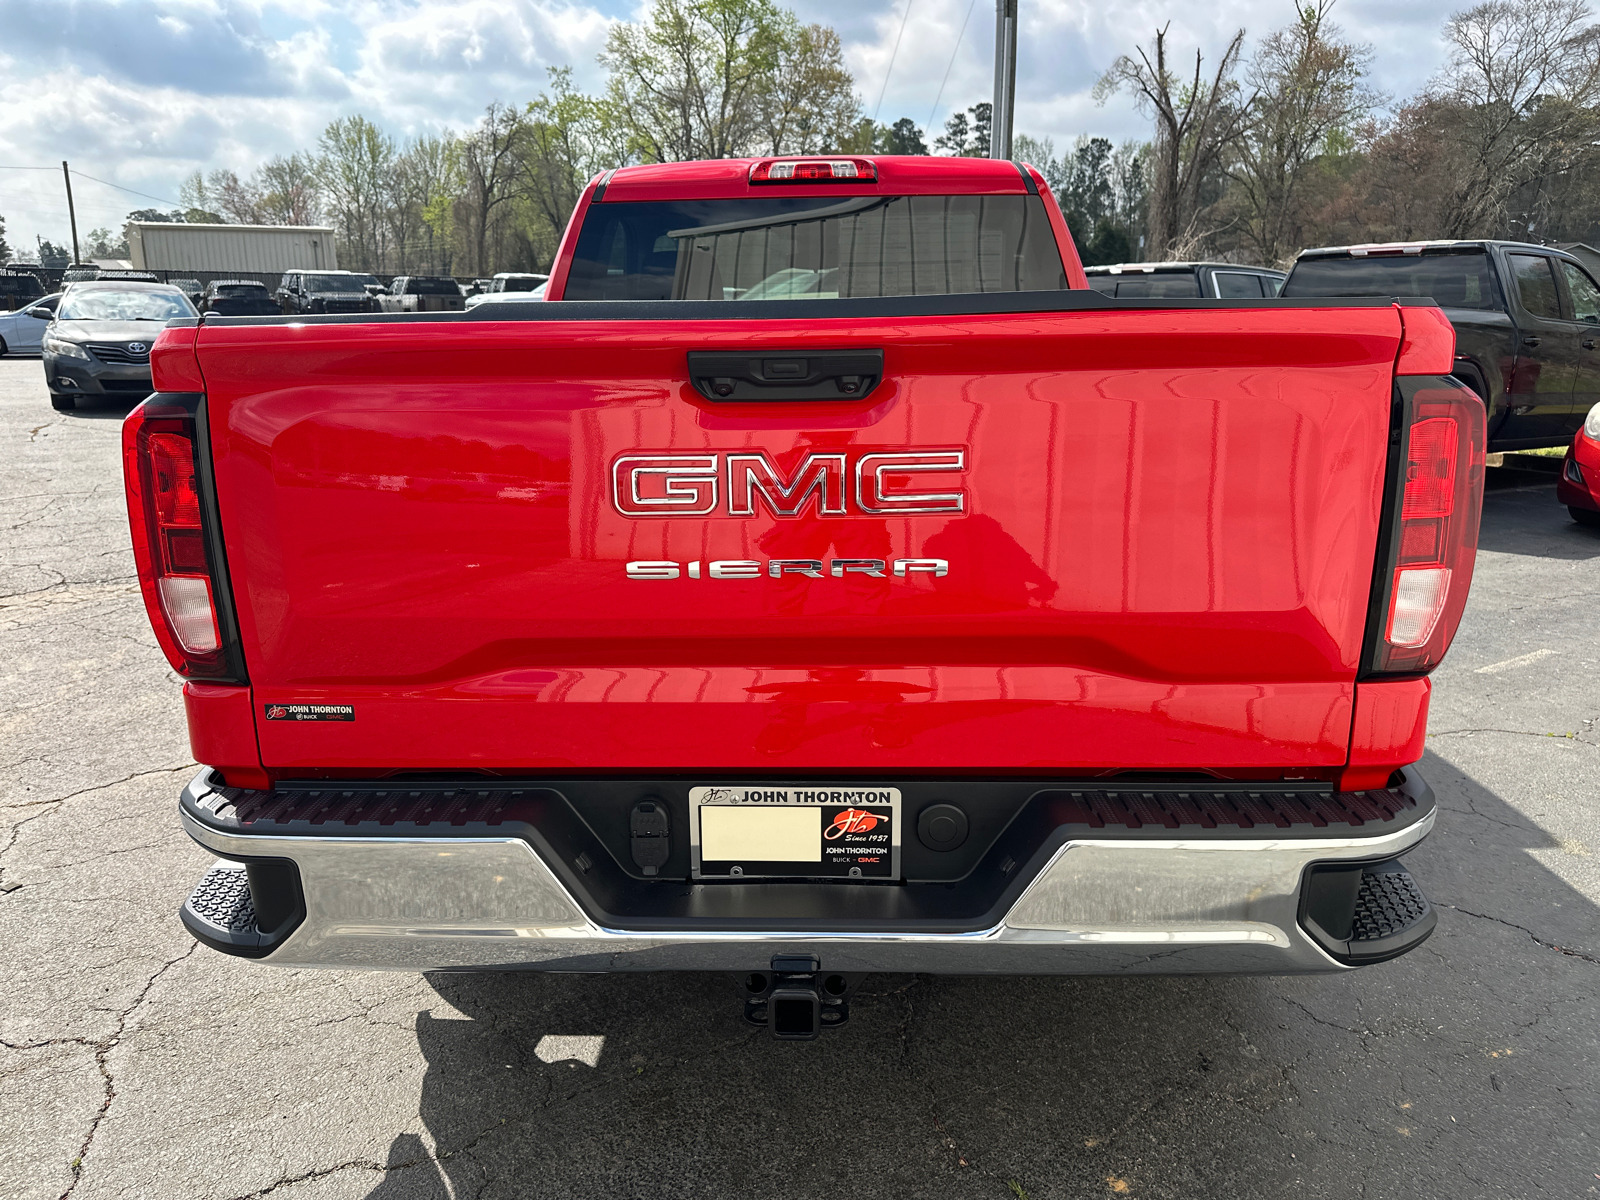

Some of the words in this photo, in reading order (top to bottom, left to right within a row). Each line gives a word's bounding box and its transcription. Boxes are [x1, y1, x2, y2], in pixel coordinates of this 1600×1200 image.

[611, 449, 966, 517] GMC
[625, 558, 949, 580] SIERRA
[289, 705, 309, 713] JOHN
[310, 705, 352, 714] THORNTON
[742, 791, 788, 803] JOHN
[794, 791, 891, 804] THORNTON
[844, 834, 867, 842] Since
[868, 834, 889, 842] 1957
